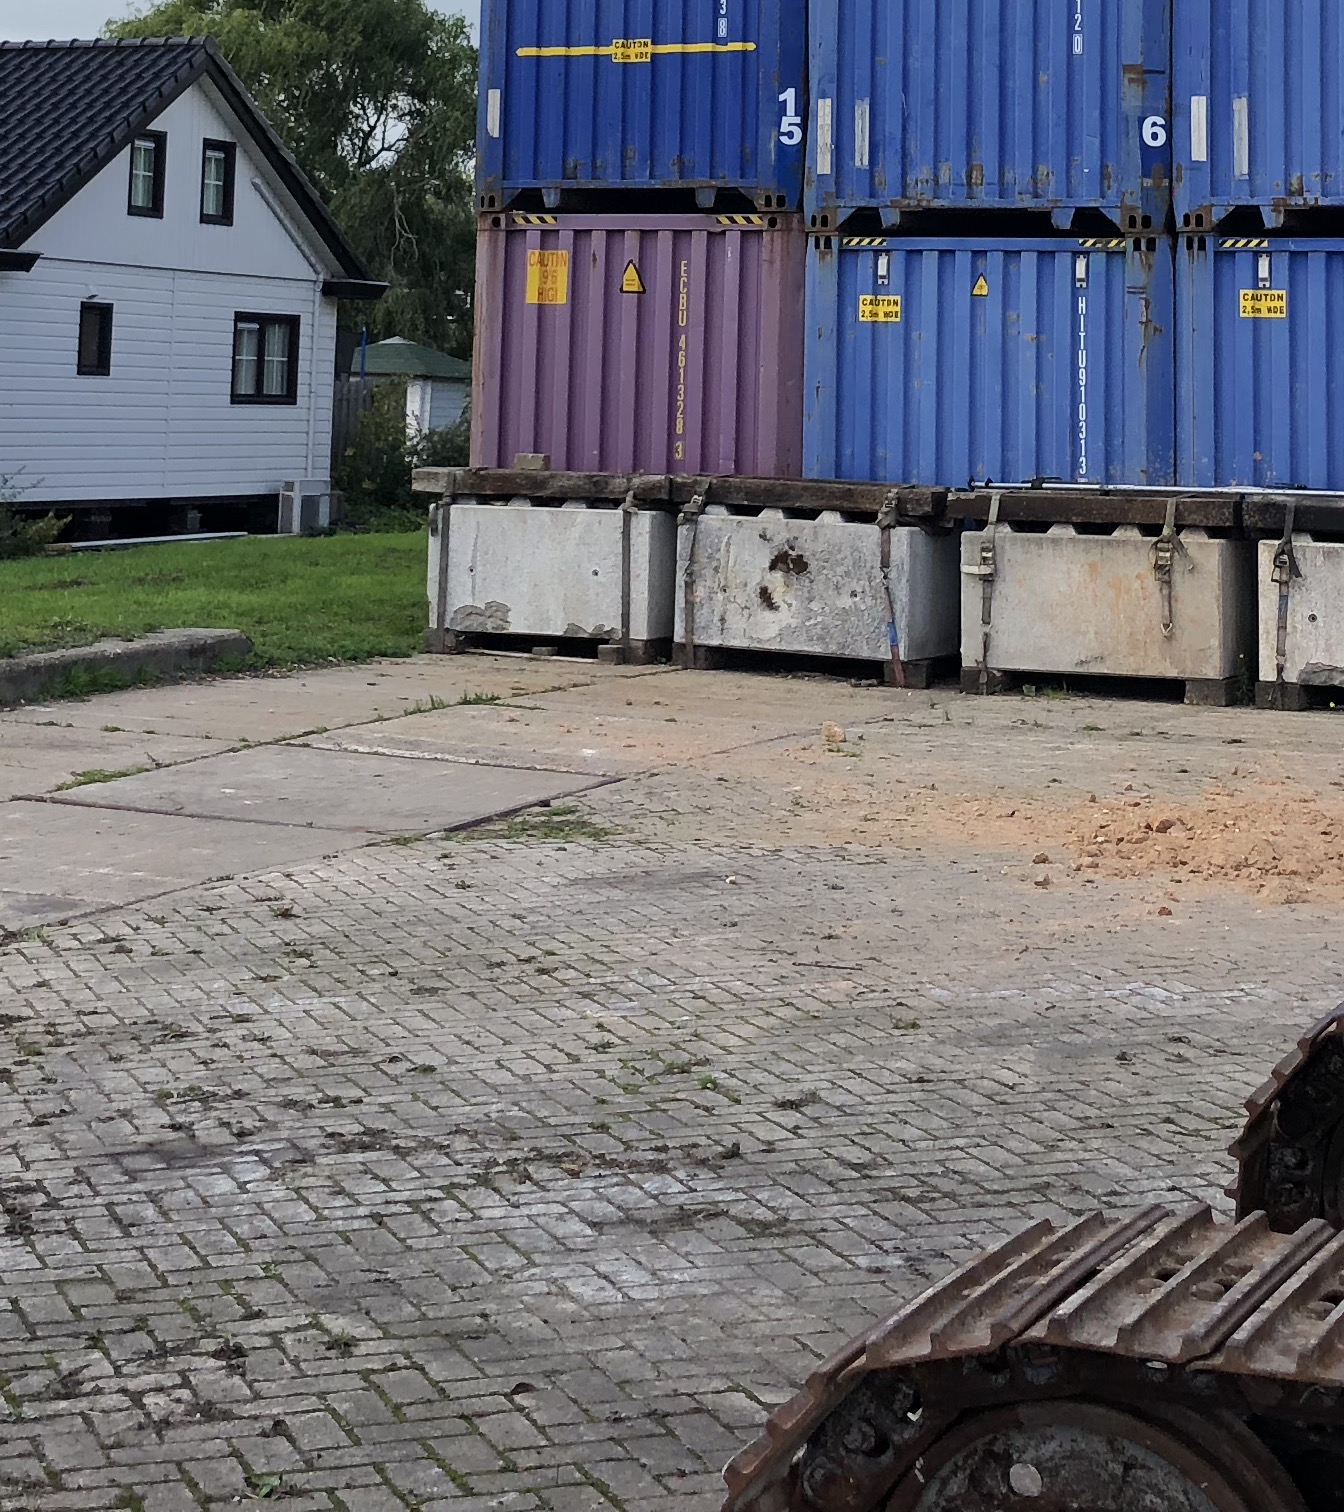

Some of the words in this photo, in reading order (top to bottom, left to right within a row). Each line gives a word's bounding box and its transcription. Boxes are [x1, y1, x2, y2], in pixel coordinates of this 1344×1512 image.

[614, 40, 649, 49] CAUTON
[1142, 116, 1167, 147] 6
[529, 251, 567, 267] CAUTIN
[1242, 293, 1284, 302] CAUTON
[862, 298, 899, 307] CAUTON
[883, 310, 899, 319] WDE
[1267, 306, 1285, 315] WDE
